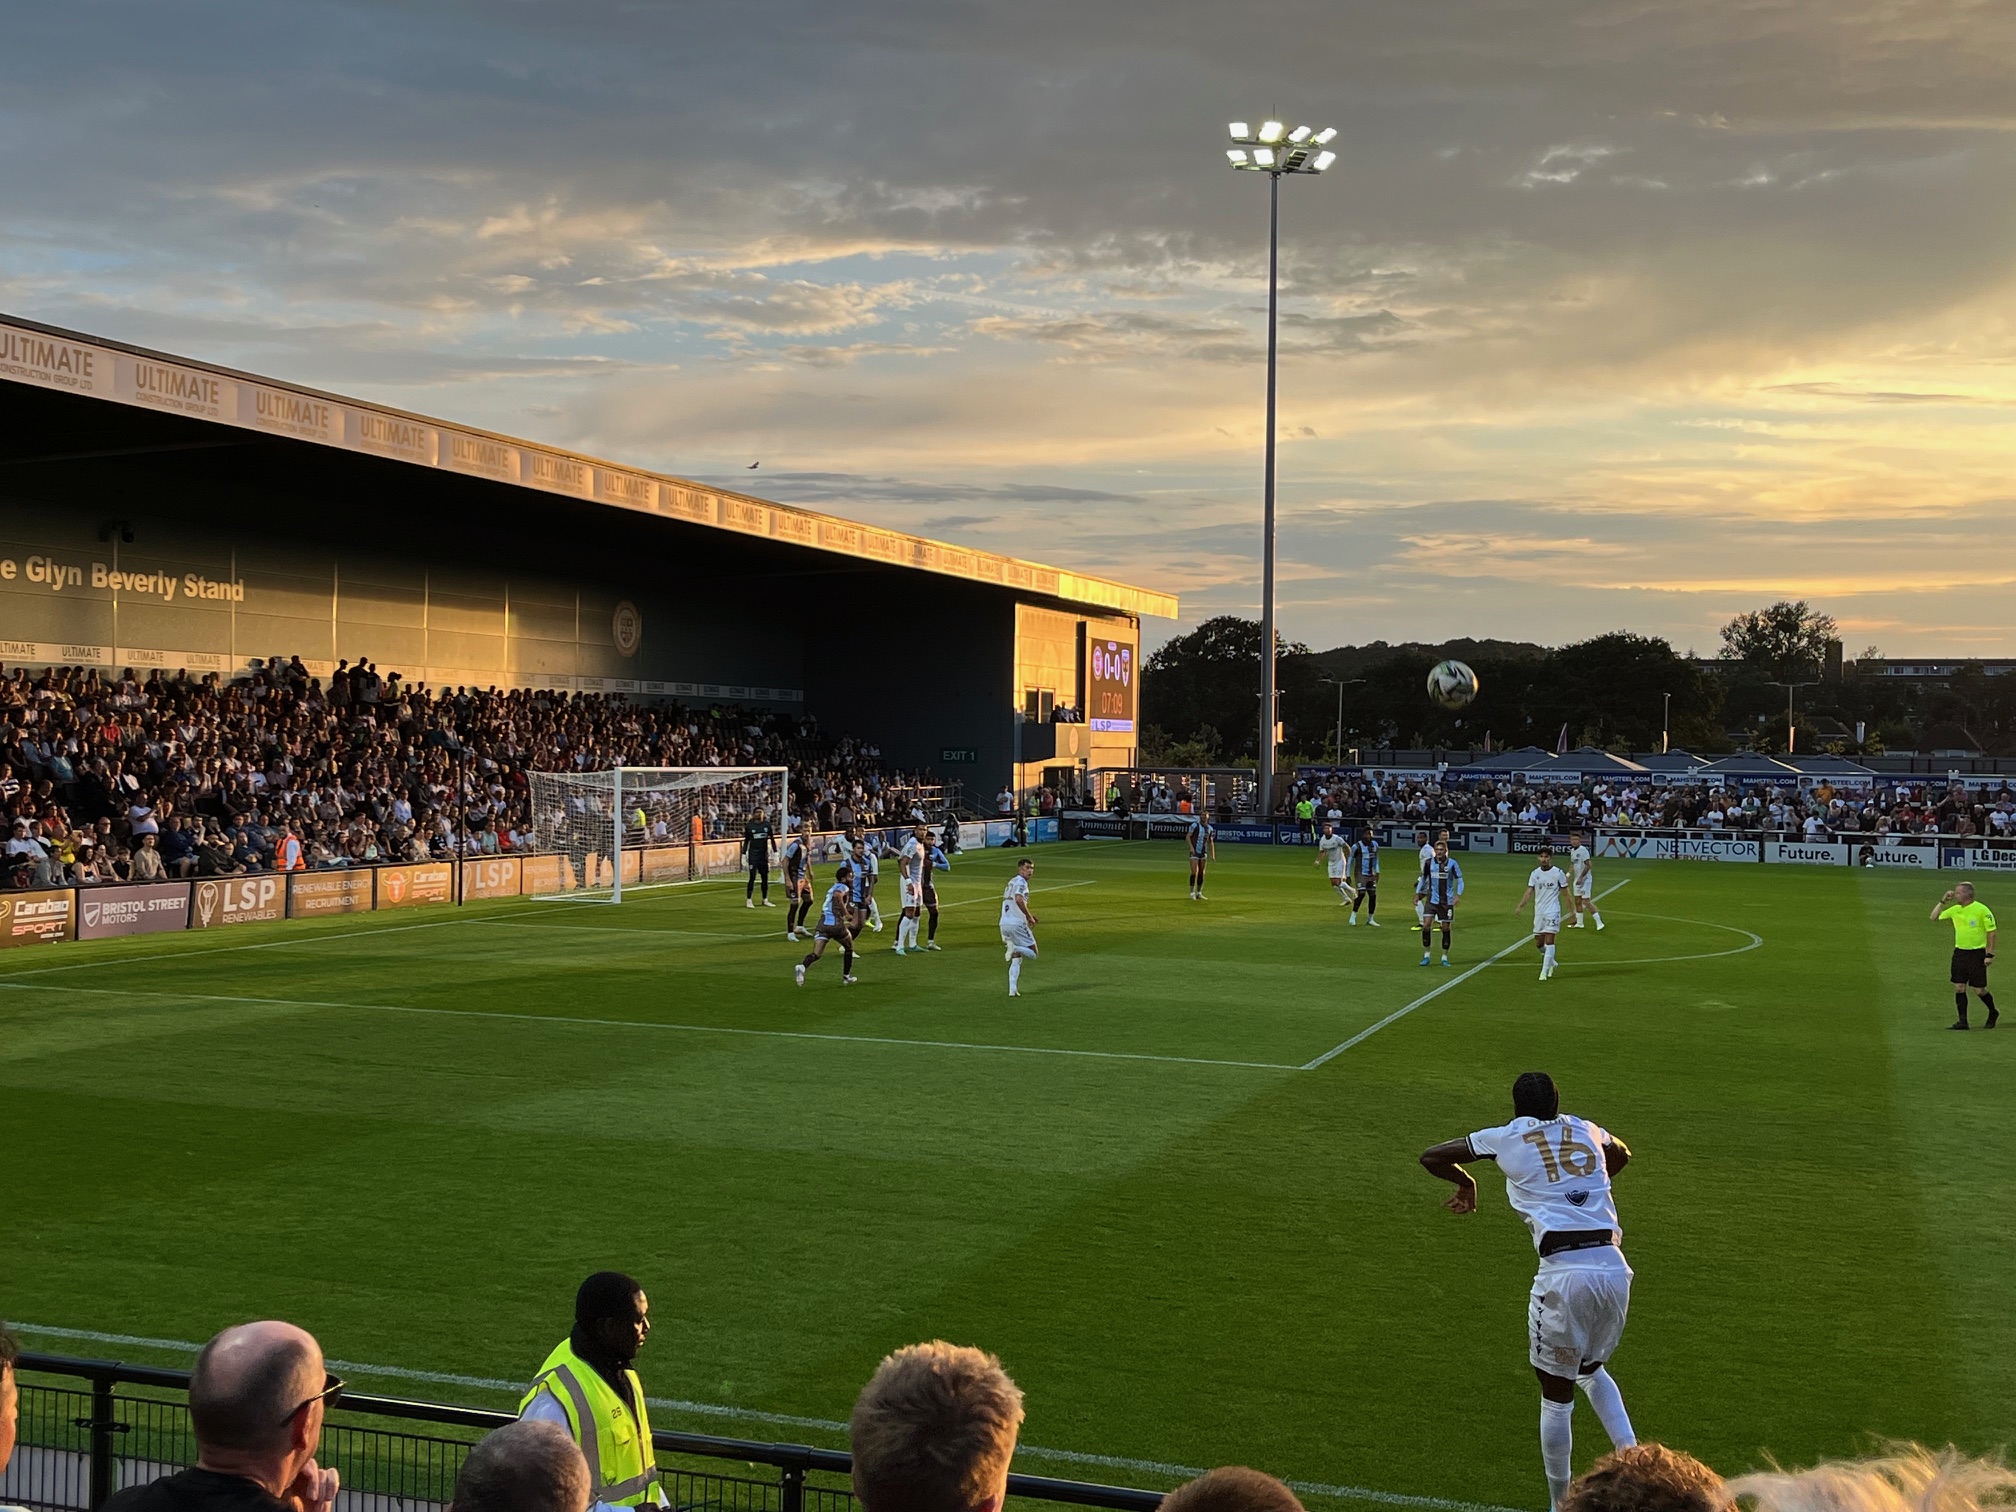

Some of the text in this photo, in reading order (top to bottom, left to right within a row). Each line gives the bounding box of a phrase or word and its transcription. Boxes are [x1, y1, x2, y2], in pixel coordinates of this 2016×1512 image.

[0, 362, 92, 390] ONSTRUCTION GROUP LTD
[136, 362, 219, 404] ULTIMATE
[256, 390, 329, 429] ULTIMATE
[361, 414, 425, 450] ULTIMATE
[452, 437, 509, 469] ULTIMATE
[533, 455, 583, 485] ULTIMATE
[604, 473, 650, 499] ULTIMATE
[668, 487, 709, 514] ULTIMATE
[726, 502, 763, 525] ULTIMATE
[778, 513, 812, 536] ULTIMATE
[25, 555, 83, 591] Glyn
[91, 562, 178, 602] Beverly
[183, 572, 245, 602] Stand
[61, 645, 101, 659] ULTIMATE
[127, 650, 164, 662] ULTIMATE
[186, 654, 221, 666] ULTIMATE
[1095, 720, 1113, 732] LSP
[943, 750, 976, 762] EXIT 1
[1075, 820, 1127, 831] Ammonite
[1149, 823, 1188, 833] Ammoni
[1217, 830, 1245, 838] BRISTOL
[1656, 840, 1757, 856] NETVECTOR
[1778, 844, 1835, 861] Future.
[1874, 851, 1923, 864] uture.
[1951, 856, 1964, 867] LG
[413, 870, 448, 883] Carabao
[475, 861, 514, 889] LSP
[292, 878, 373, 895] RENEWABLE ENERGY
[411, 888, 446, 899] SPORT
[223, 879, 276, 913] LSP
[305, 895, 359, 910] RECRUITMENT
[14, 898, 70, 917] Carabao
[102, 897, 187, 915] BRISTOL STREET
[101, 913, 138, 925] MOTORS
[222, 909, 277, 924] RENEWABLES
[11, 921, 67, 936] SPORT
[1521, 1124, 1597, 1183] 16
